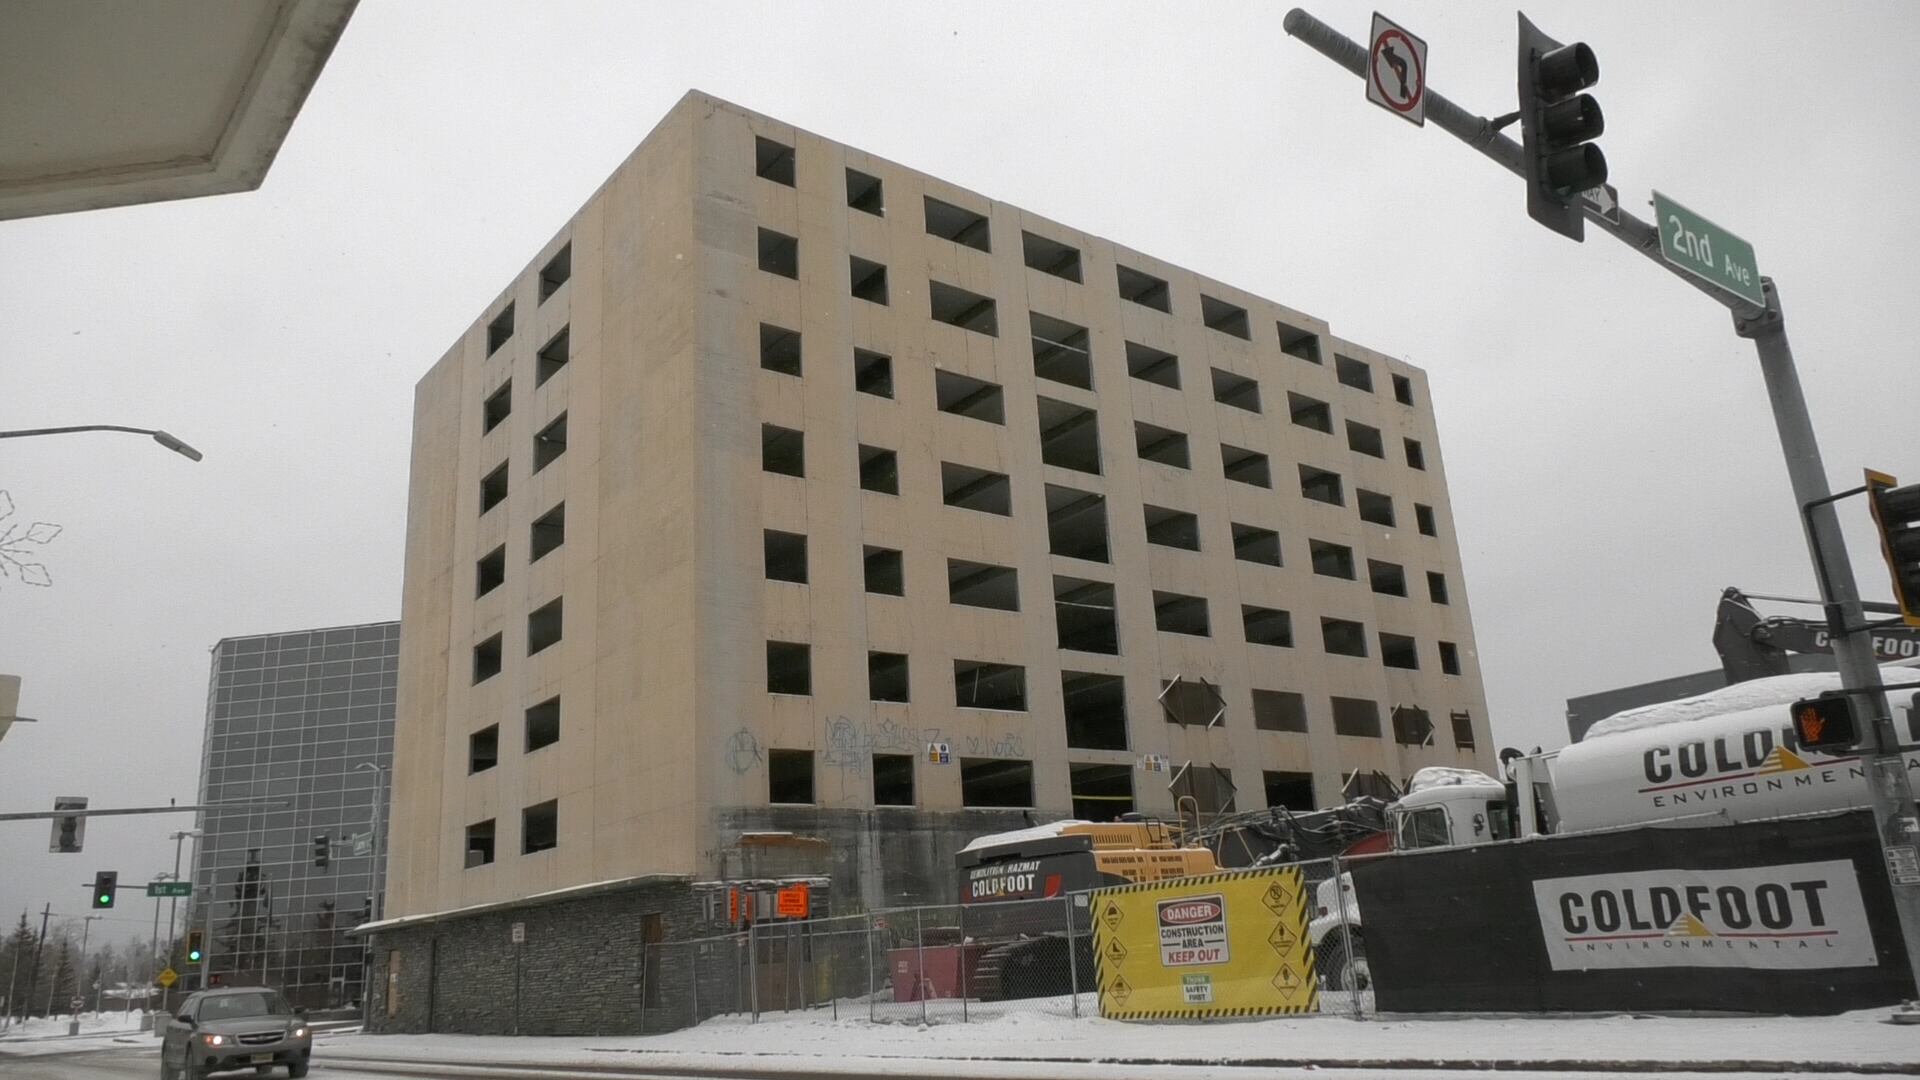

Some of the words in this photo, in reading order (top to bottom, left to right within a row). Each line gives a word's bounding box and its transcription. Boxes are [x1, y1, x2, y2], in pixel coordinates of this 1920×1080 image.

[1669, 215, 1714, 268] 2nd
[1725, 254, 1751, 287] Ave
[1653, 758, 1920, 808] ENVIRONMENA
[972, 874, 1035, 897] COLDFOOT
[1167, 905, 1212, 920] DANGER
[1559, 880, 1828, 934] COLDFOOT
[1161, 924, 1224, 939] CONSTRUCTION
[1182, 939, 1204, 949] AREA
[1568, 938, 1834, 952] ENVIRONMENTAL
[1168, 950, 1195, 963] KEEP
[1198, 949, 1220, 961] OUT
[1185, 985, 1208, 993] SAFETY
